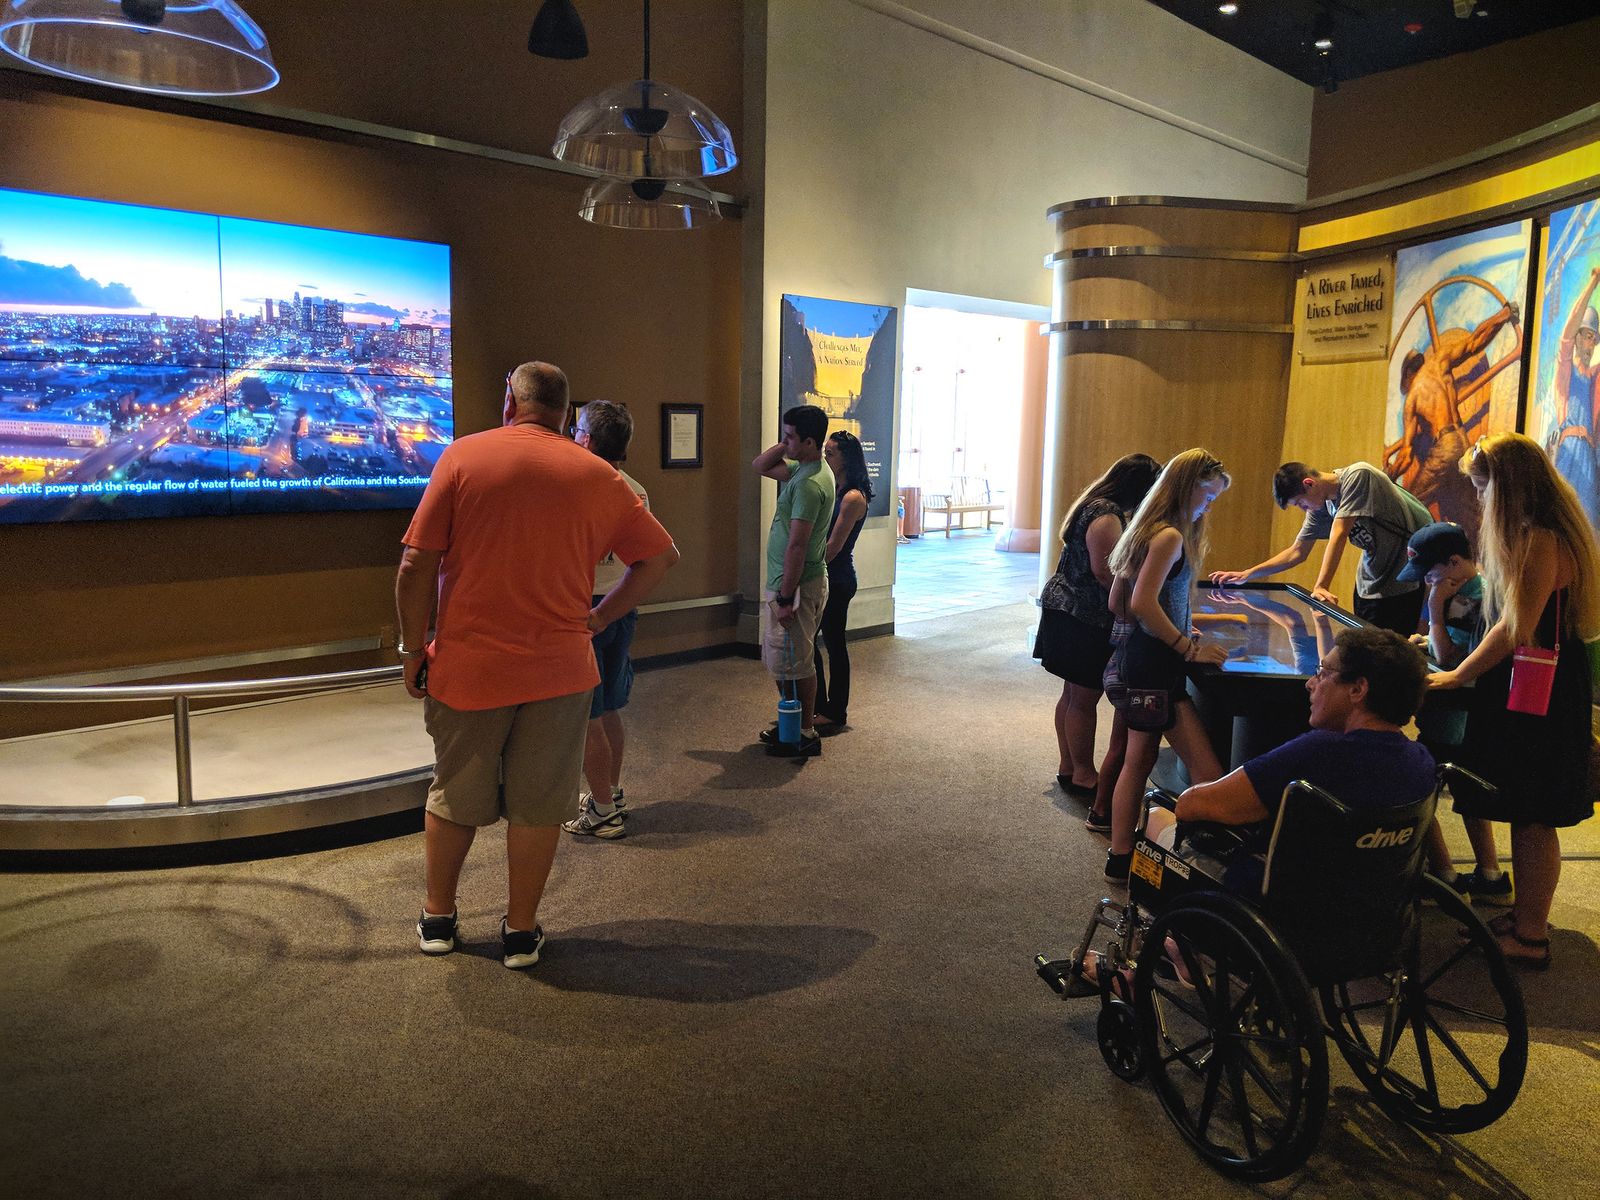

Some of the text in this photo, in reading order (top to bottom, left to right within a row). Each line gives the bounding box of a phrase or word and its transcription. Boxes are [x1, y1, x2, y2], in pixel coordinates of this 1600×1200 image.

[1307, 281, 1315, 296] A
[0, 483, 43, 495] electric
[45, 484, 79, 496] power
[81, 481, 102, 492] and
[105, 481, 122, 492] the
[125, 480, 161, 492] regular
[164, 479, 186, 490] flow
[188, 479, 199, 489] of
[201, 479, 228, 489] water
[230, 478, 260, 488] fueled
[262, 478, 278, 487] the
[279, 477, 311, 489] growth
[312, 477, 322, 486] of
[324, 476, 365, 486] California
[366, 476, 382, 485] and
[383, 476, 397, 485] the
[1355, 826, 1414, 849] drive
[1135, 840, 1162, 863] drive
